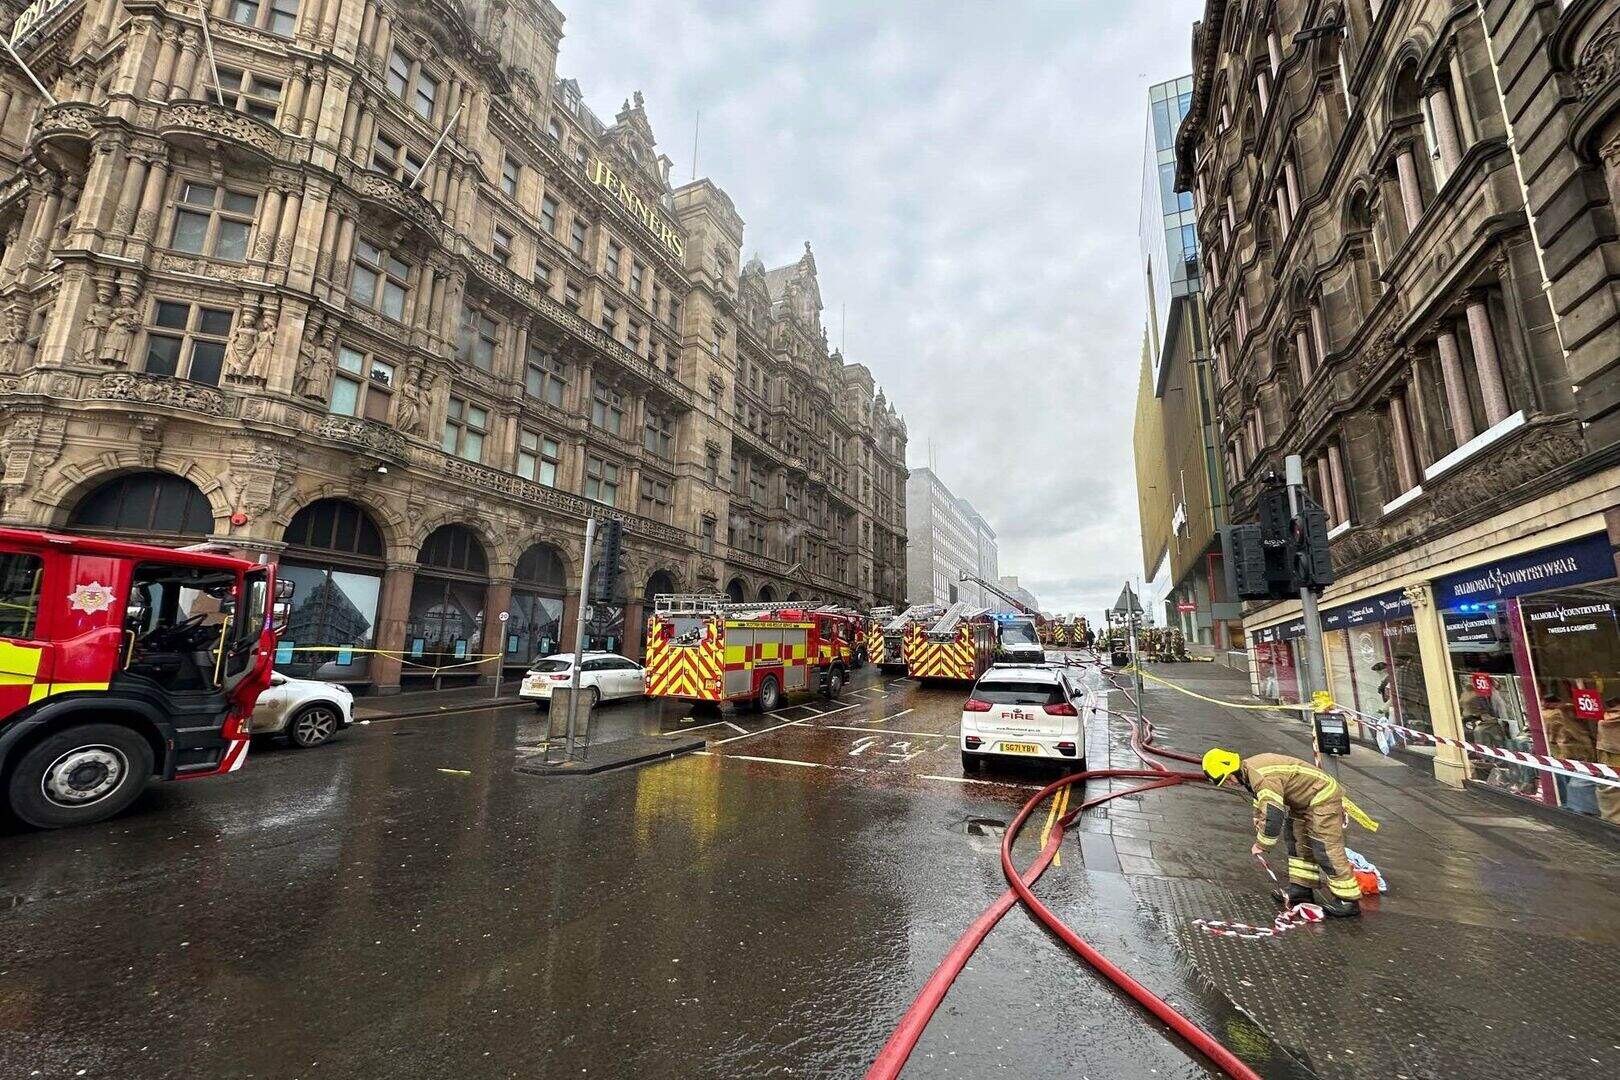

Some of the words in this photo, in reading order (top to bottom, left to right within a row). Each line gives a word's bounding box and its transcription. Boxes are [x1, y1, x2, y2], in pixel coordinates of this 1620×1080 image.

[585, 157, 683, 257] JENNERS
[1453, 577, 1494, 596] BALMORAL
[1502, 557, 1577, 586] COUNTRYWEAR
[1530, 610, 1560, 621] BALMORAL
[1563, 604, 1611, 616] COUNTRYWEAR
[1001, 712, 1034, 720] FIRE
